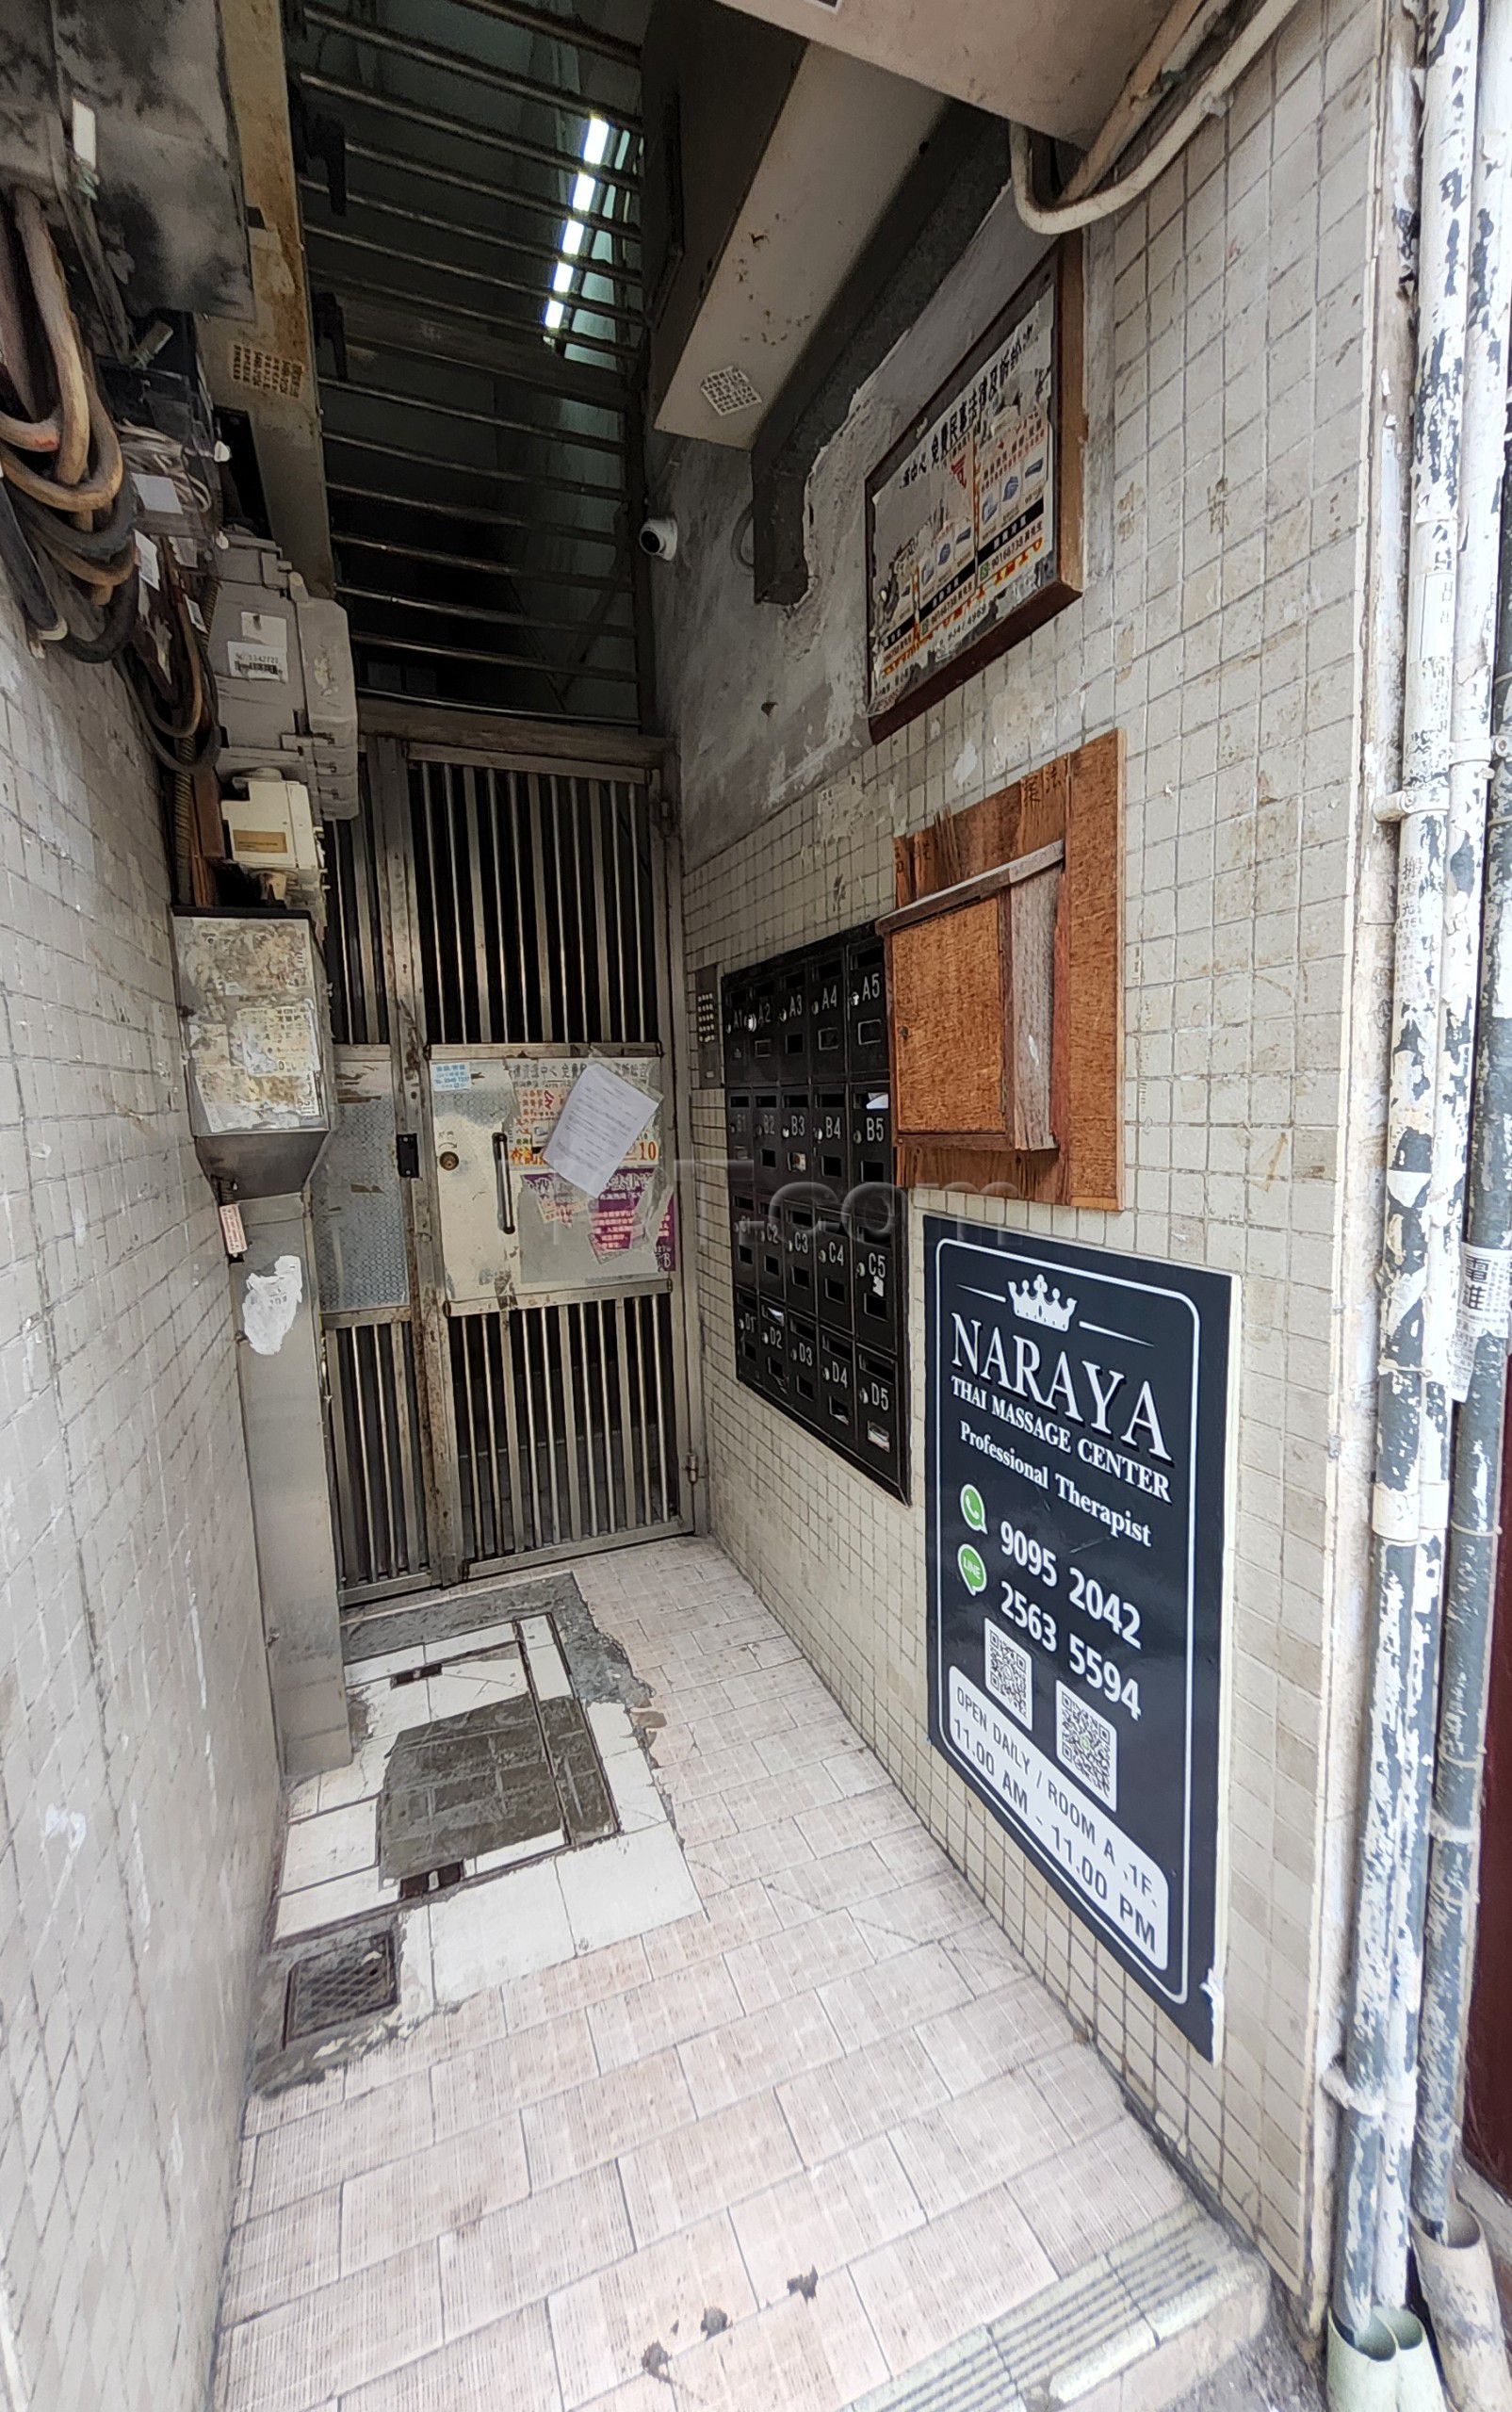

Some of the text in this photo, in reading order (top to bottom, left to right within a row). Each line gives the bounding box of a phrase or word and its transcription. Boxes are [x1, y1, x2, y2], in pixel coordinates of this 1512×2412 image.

[758, 1002, 771, 1023] A2
[789, 995, 802, 1016] A3
[821, 985, 837, 1010] A4
[862, 972, 880, 1002] A5
[763, 1114, 775, 1135] B2
[791, 1115, 805, 1137] B3
[825, 1116, 841, 1140] B4
[867, 1116, 885, 1143] B5
[765, 1223, 778, 1245] C2
[794, 1231, 808, 1254] C3
[828, 1241, 844, 1266] C4
[868, 1252, 886, 1279] C5
[745, 1312, 888, 1411] D1 D2 D3 D4 D5
[951, 1312, 1173, 1462] NARAYA
[951, 1375, 1172, 1505] THAI MASSAGE CENTER
[960, 1420, 1152, 1548] Professional Therapist
[1000, 1521, 1142, 1650] 9095 2042
[1000, 1581, 1142, 1721] 2563 5594
[953, 1719, 995, 1776] 11.00
[1002, 1771, 1029, 1815] AM
[1052, 1826, 1108, 1900] 11.00
[1119, 1894, 1156, 1953] PM
[957, 1687, 987, 1731] OPEN
[993, 1722, 1030, 1773] DAILY
[1049, 1780, 1096, 1845] ROOM
[1103, 1837, 1115, 1866] A
